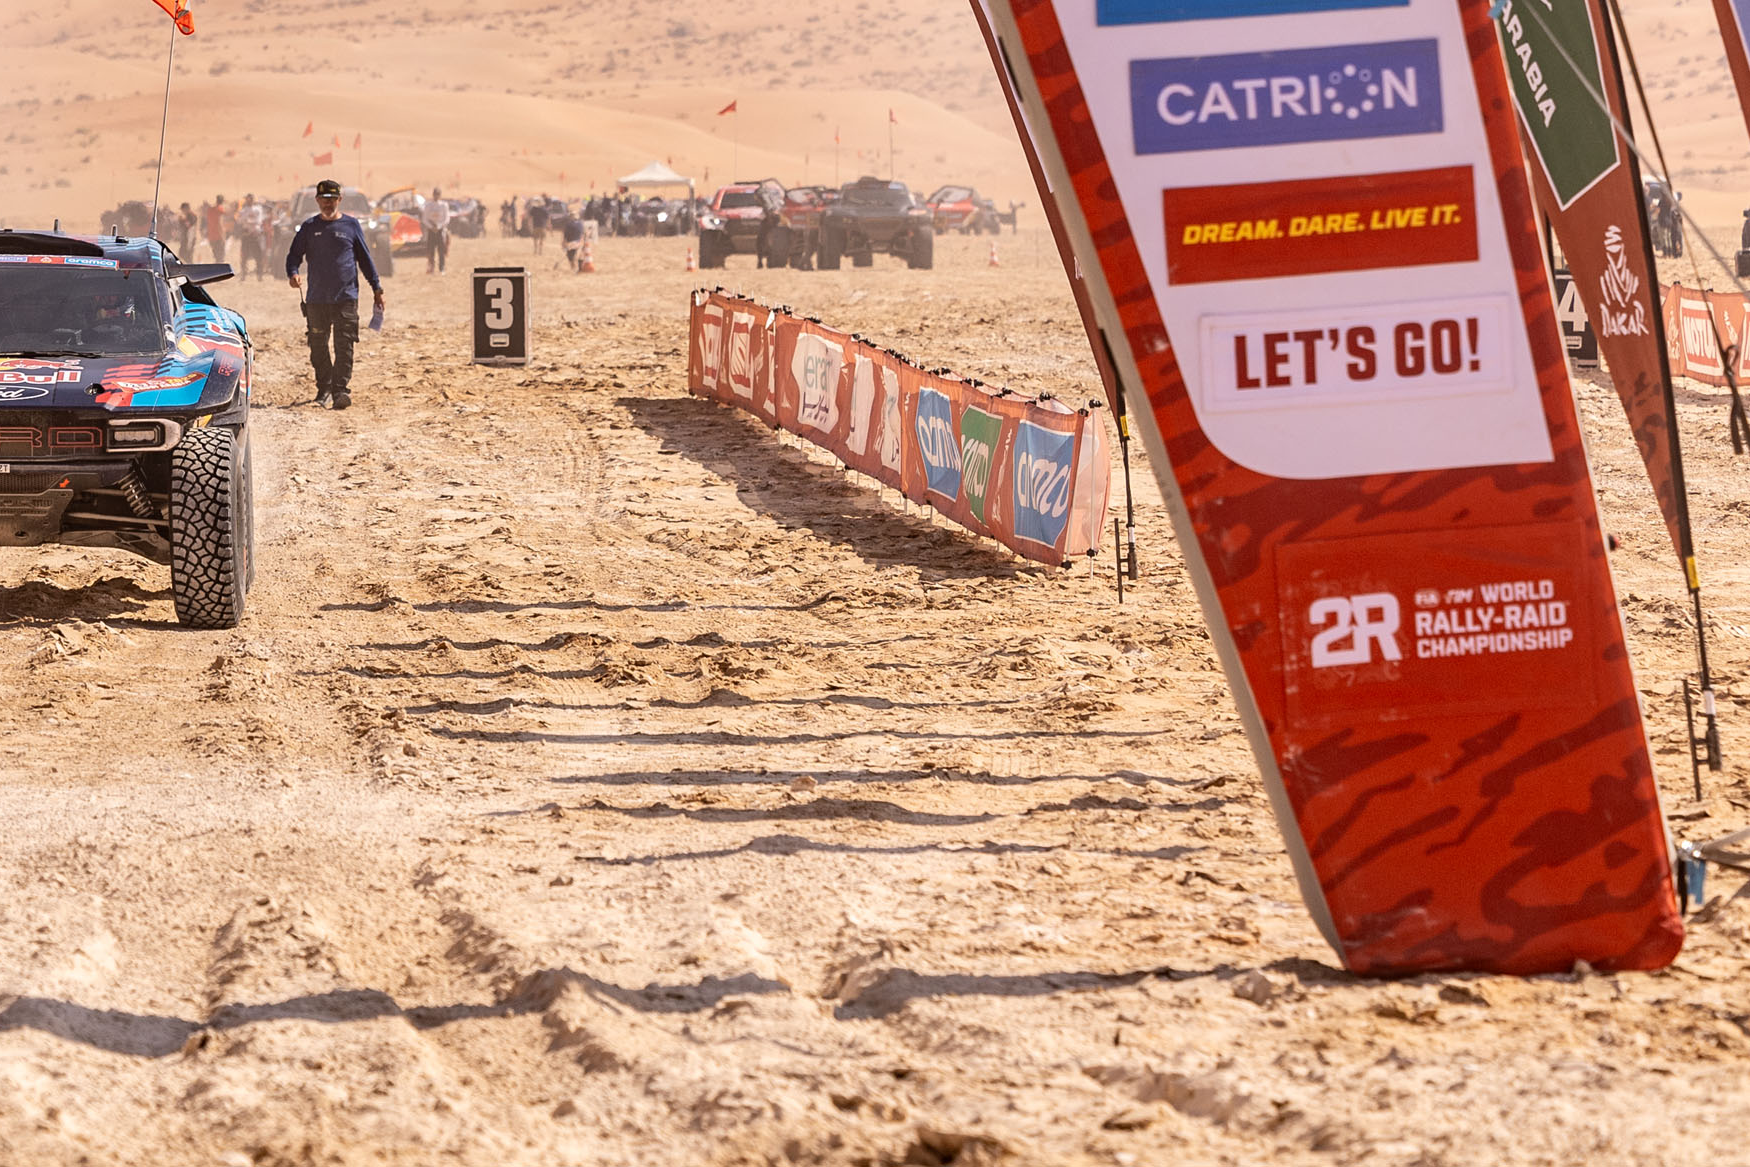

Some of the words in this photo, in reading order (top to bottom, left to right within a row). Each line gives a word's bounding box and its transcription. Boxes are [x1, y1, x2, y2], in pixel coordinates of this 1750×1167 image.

[1156, 63, 1419, 125] CATRION
[1182, 219, 1283, 245] DREAM.
[1289, 212, 1364, 237] DARE.
[1370, 206, 1427, 230] LIVE
[1431, 204, 1461, 225] IT.
[67, 258, 115, 266] aramco
[484, 278, 514, 329] 3
[1557, 281, 1589, 332] 4
[1600, 300, 1649, 338] DAKAR
[1234, 325, 1377, 391] LET'S
[1394, 317, 1481, 379] GO!
[1480, 579, 1554, 604] WORLD
[1415, 601, 1567, 636] RALLY-RAID
[1416, 628, 1574, 659] CHAMPIONSHIP
